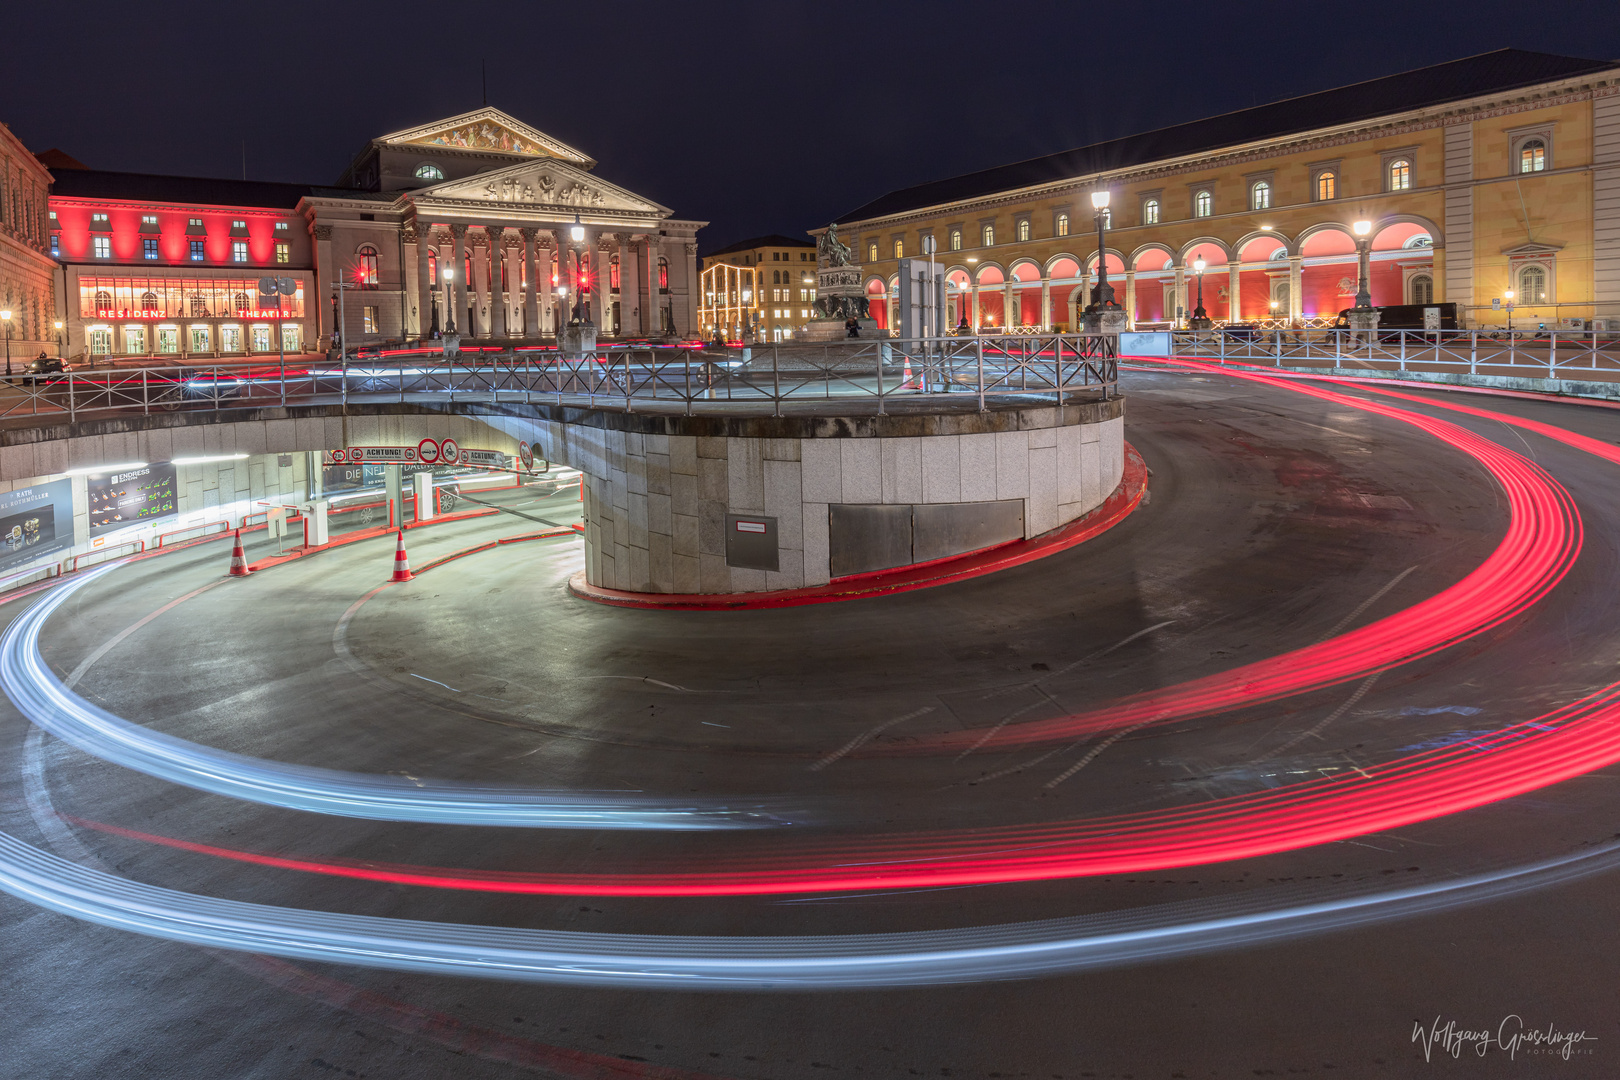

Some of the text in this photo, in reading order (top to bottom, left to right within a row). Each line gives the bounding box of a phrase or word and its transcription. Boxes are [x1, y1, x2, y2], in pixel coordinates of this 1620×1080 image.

[99, 310, 166, 318] RESIDENZ
[118, 468, 150, 480] ENDRESS
[345, 466, 386, 480] DIE NEU
[10, 492, 49, 507] ROTHMÜLLER
[16, 489, 33, 498] RATH
